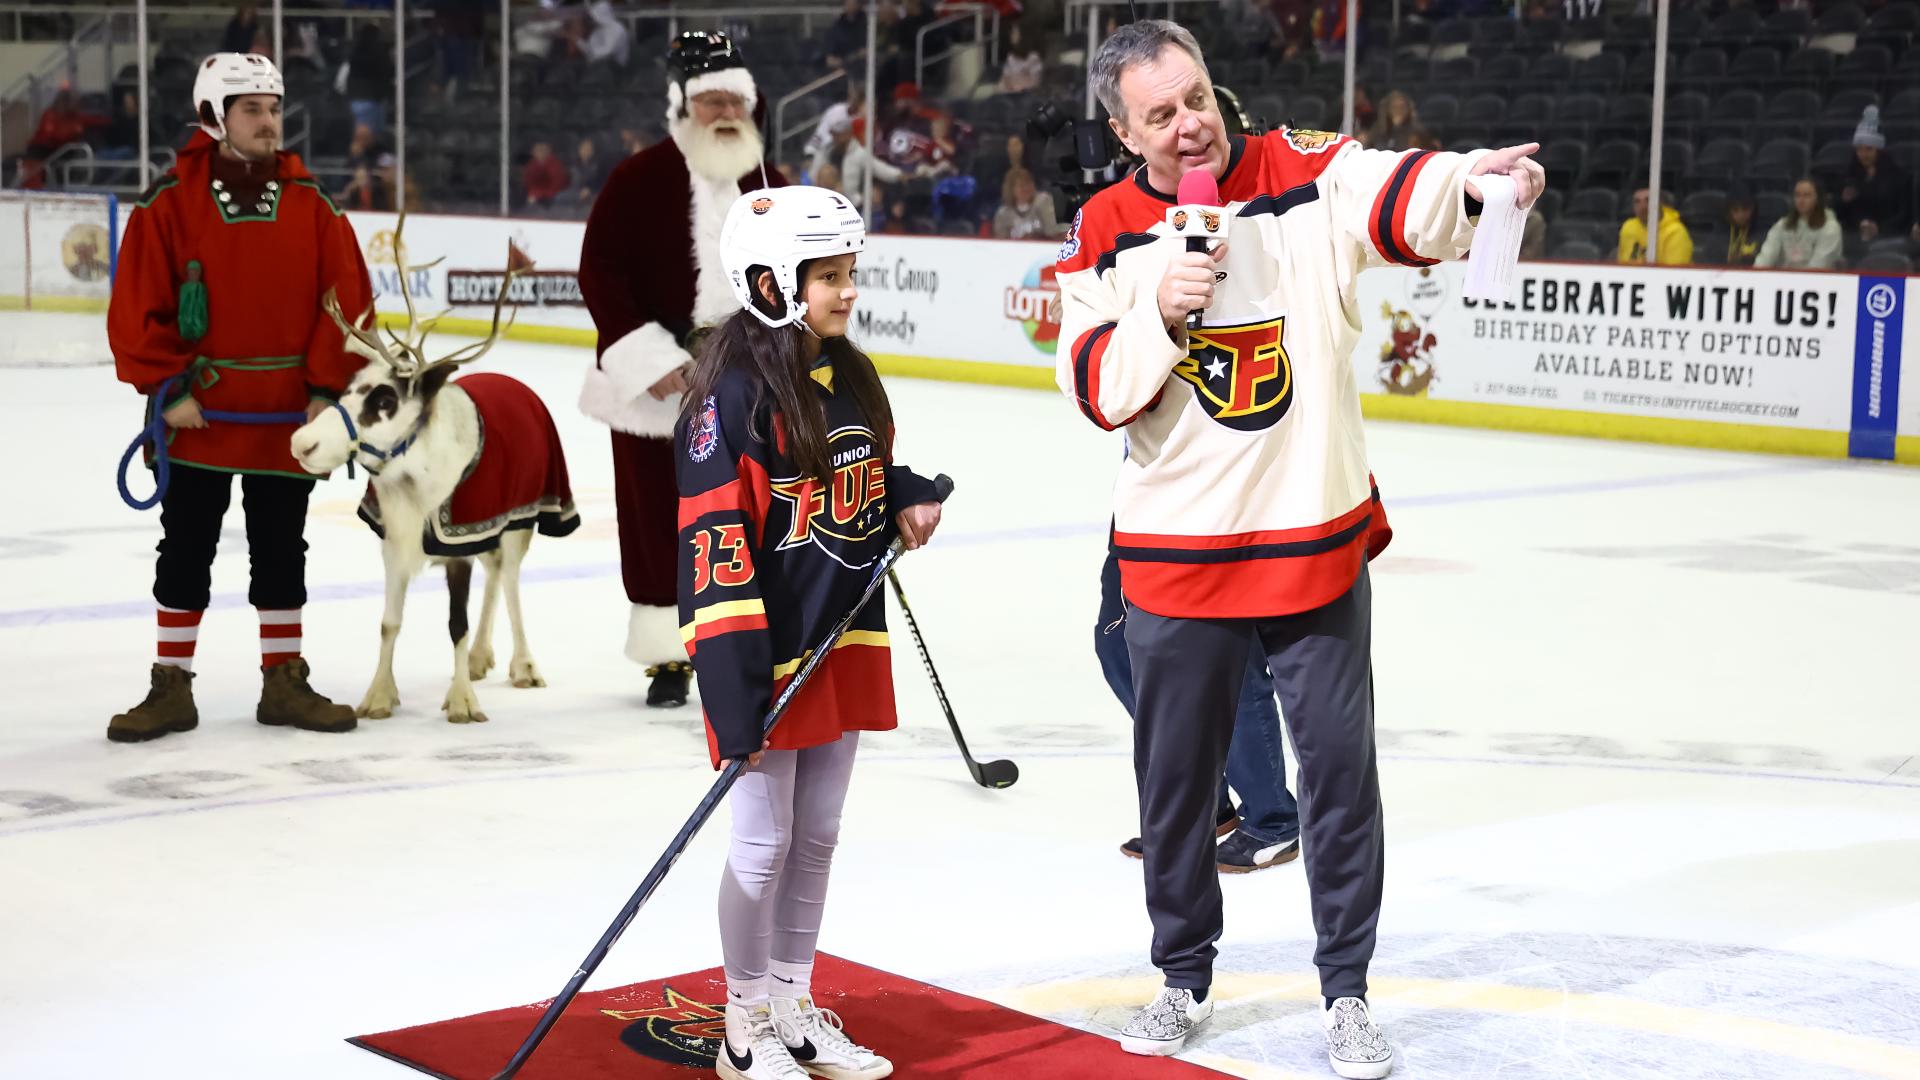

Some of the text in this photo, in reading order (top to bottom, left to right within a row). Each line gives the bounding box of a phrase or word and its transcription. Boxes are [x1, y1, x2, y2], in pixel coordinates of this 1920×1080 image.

[895, 257, 939, 303] Group
[1665, 283, 1754, 324] WITH
[1774, 289, 1838, 329] US!
[857, 309, 918, 346] Moody
[1473, 318, 1822, 360] BIRTHDAY PARTY OPTIONS
[1533, 352, 1754, 389] AVAILABLE NOW!
[829, 444, 871, 467] UNIOR
[769, 456, 886, 545] FUE
